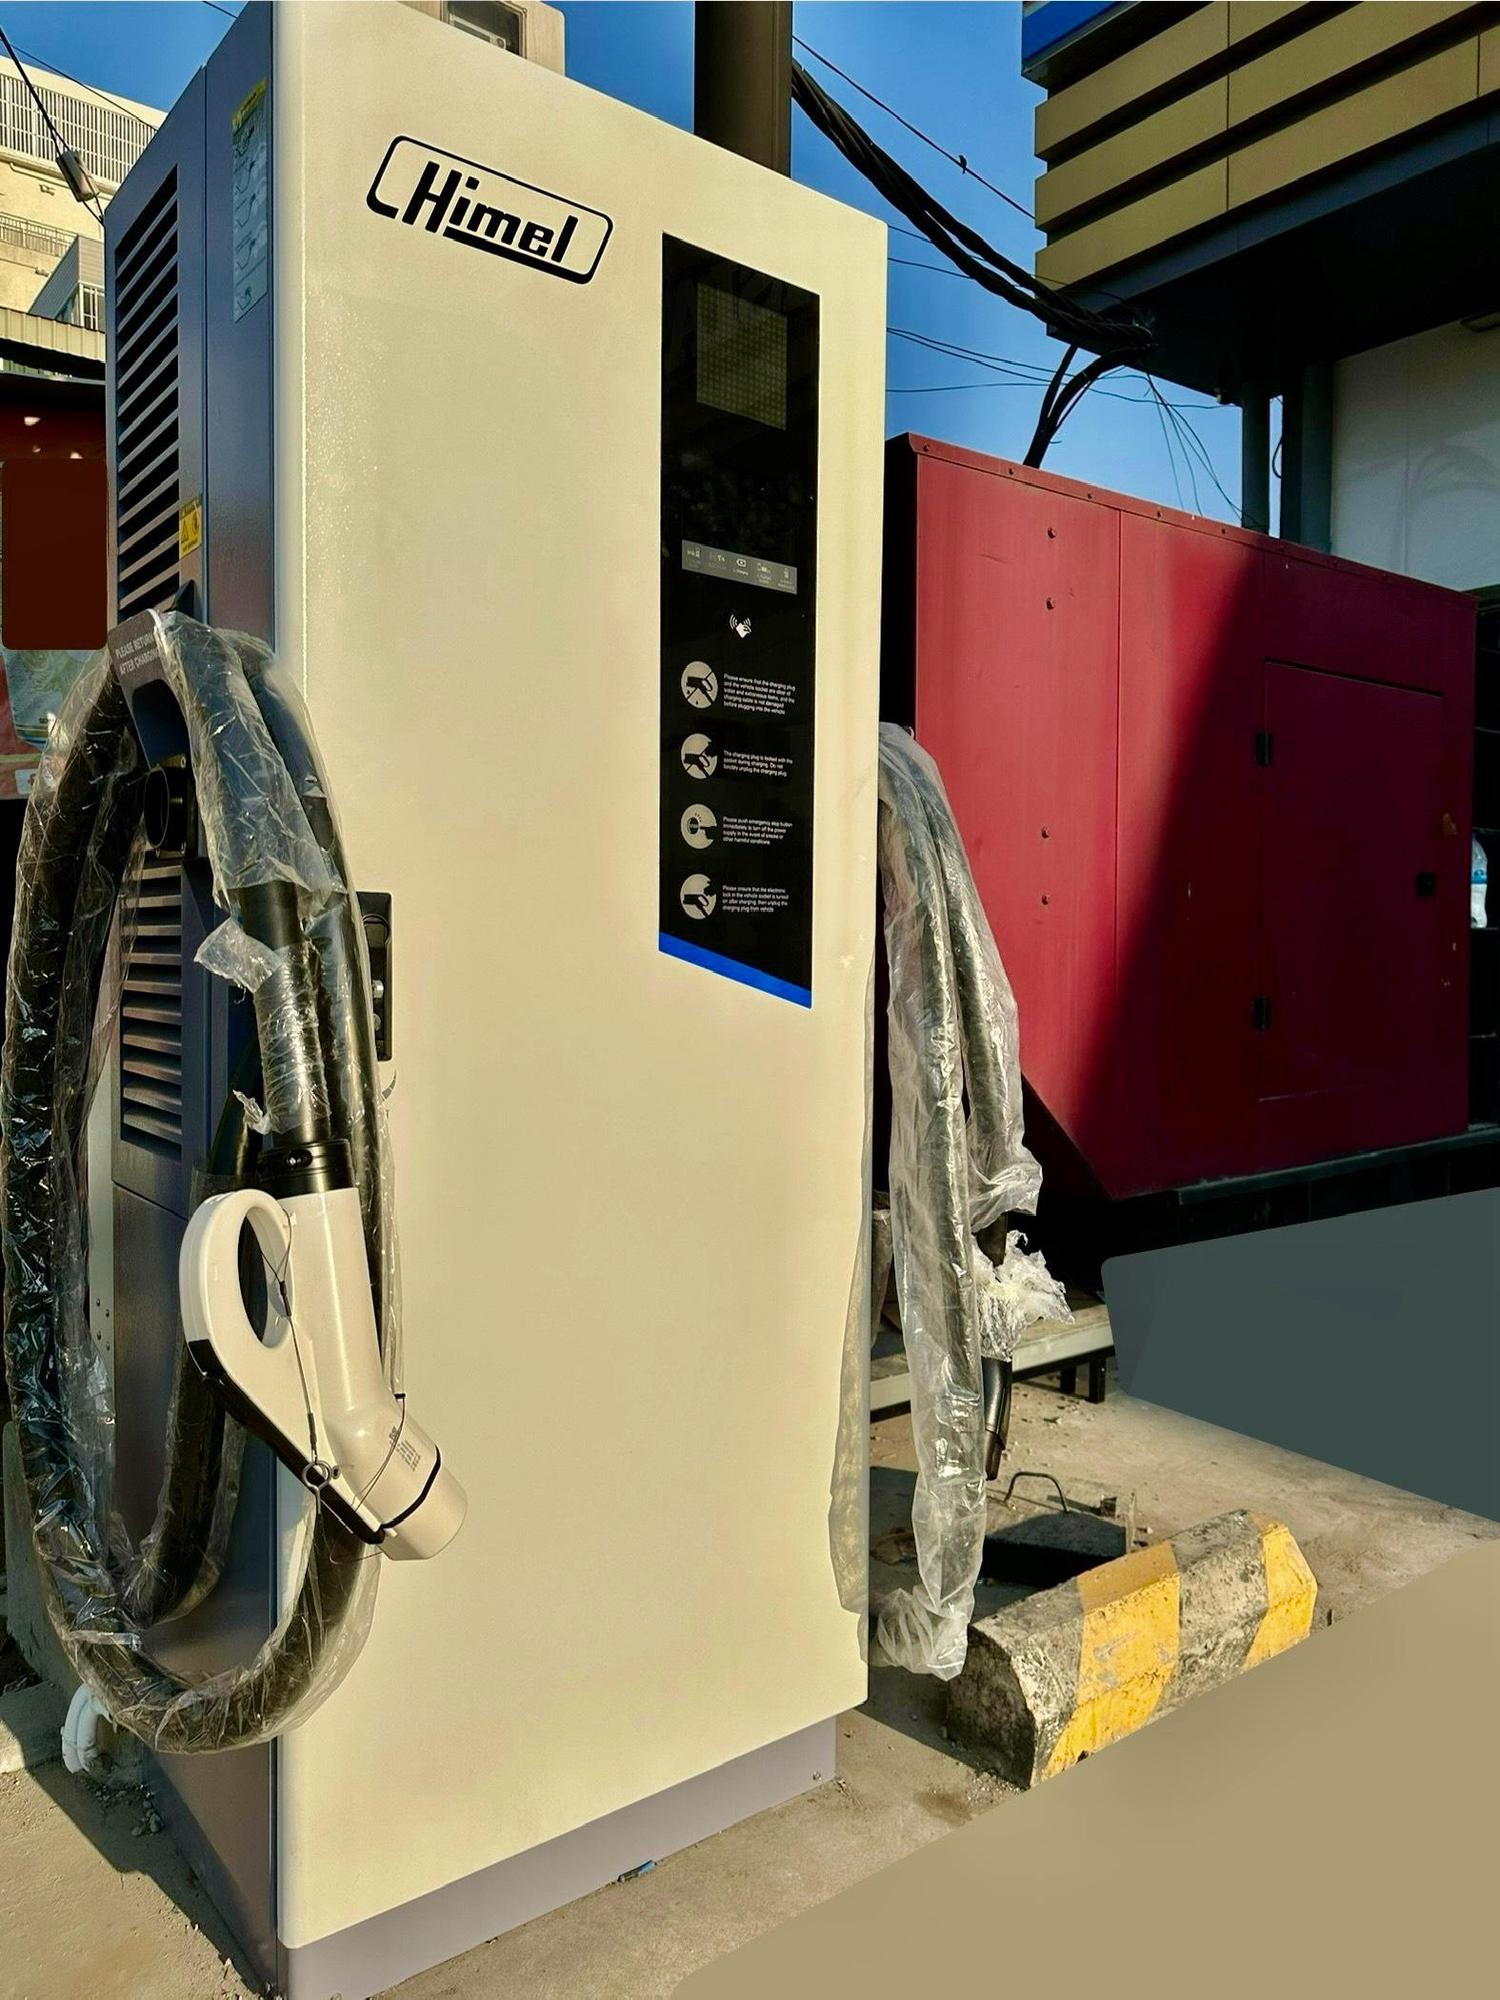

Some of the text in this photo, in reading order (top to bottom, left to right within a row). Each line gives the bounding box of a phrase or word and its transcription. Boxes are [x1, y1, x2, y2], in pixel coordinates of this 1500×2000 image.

[401, 160, 579, 263] Himel
[115, 641, 134, 659] PLEASE
[119, 659, 136, 675] AFTER
[724, 673, 738, 681] Please
[770, 682, 786, 690] charging
[724, 694, 741, 702] charging
[733, 752, 750, 760] charging
